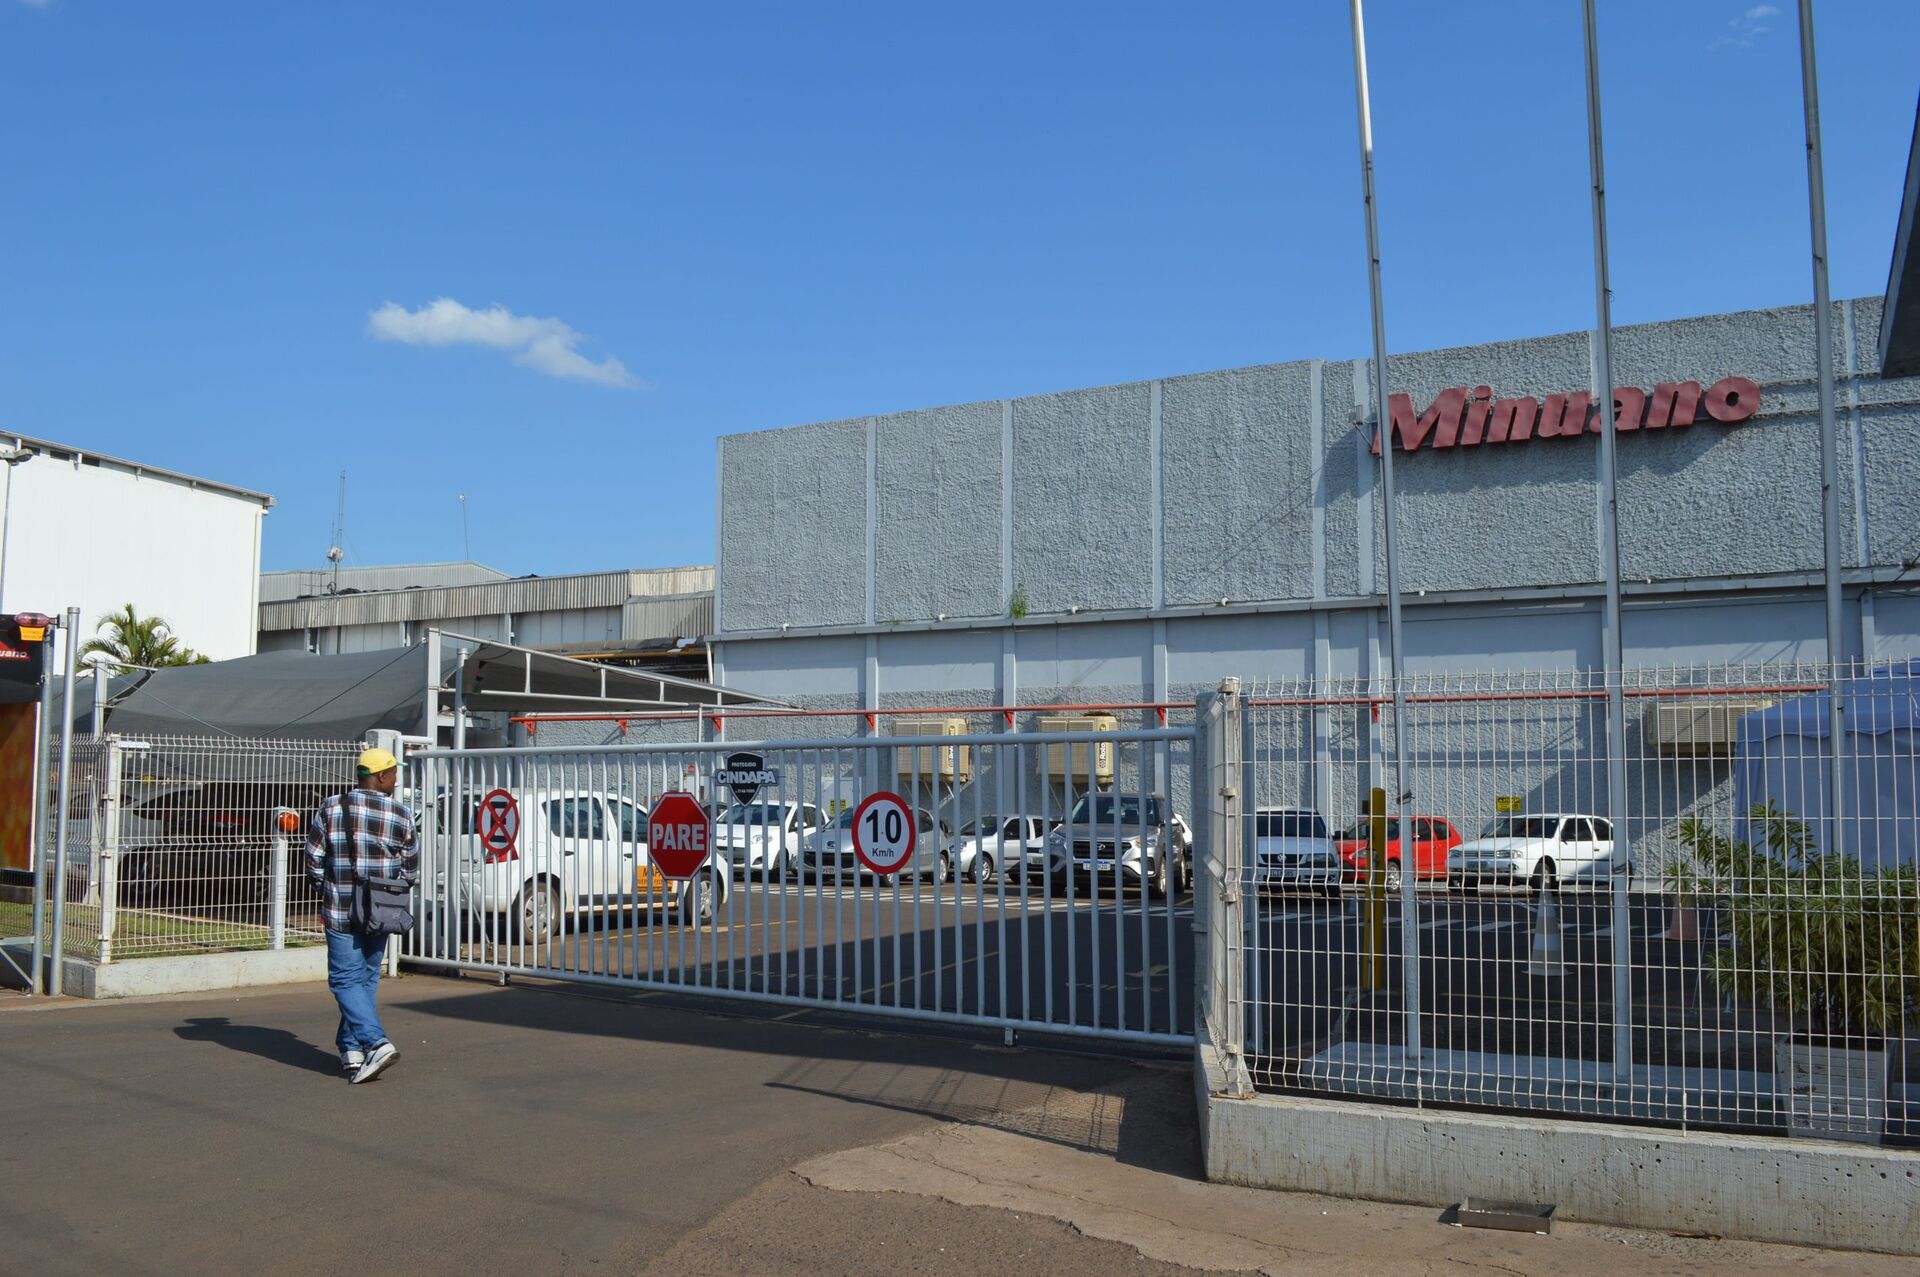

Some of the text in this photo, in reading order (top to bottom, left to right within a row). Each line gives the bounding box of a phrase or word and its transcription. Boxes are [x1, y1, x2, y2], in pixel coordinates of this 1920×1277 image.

[1370, 376, 1760, 454] Minuano
[717, 770, 777, 784] CINDAPA
[652, 823, 705, 851] PARE
[866, 809, 902, 844] 10
[872, 848, 895, 857] Km/h
